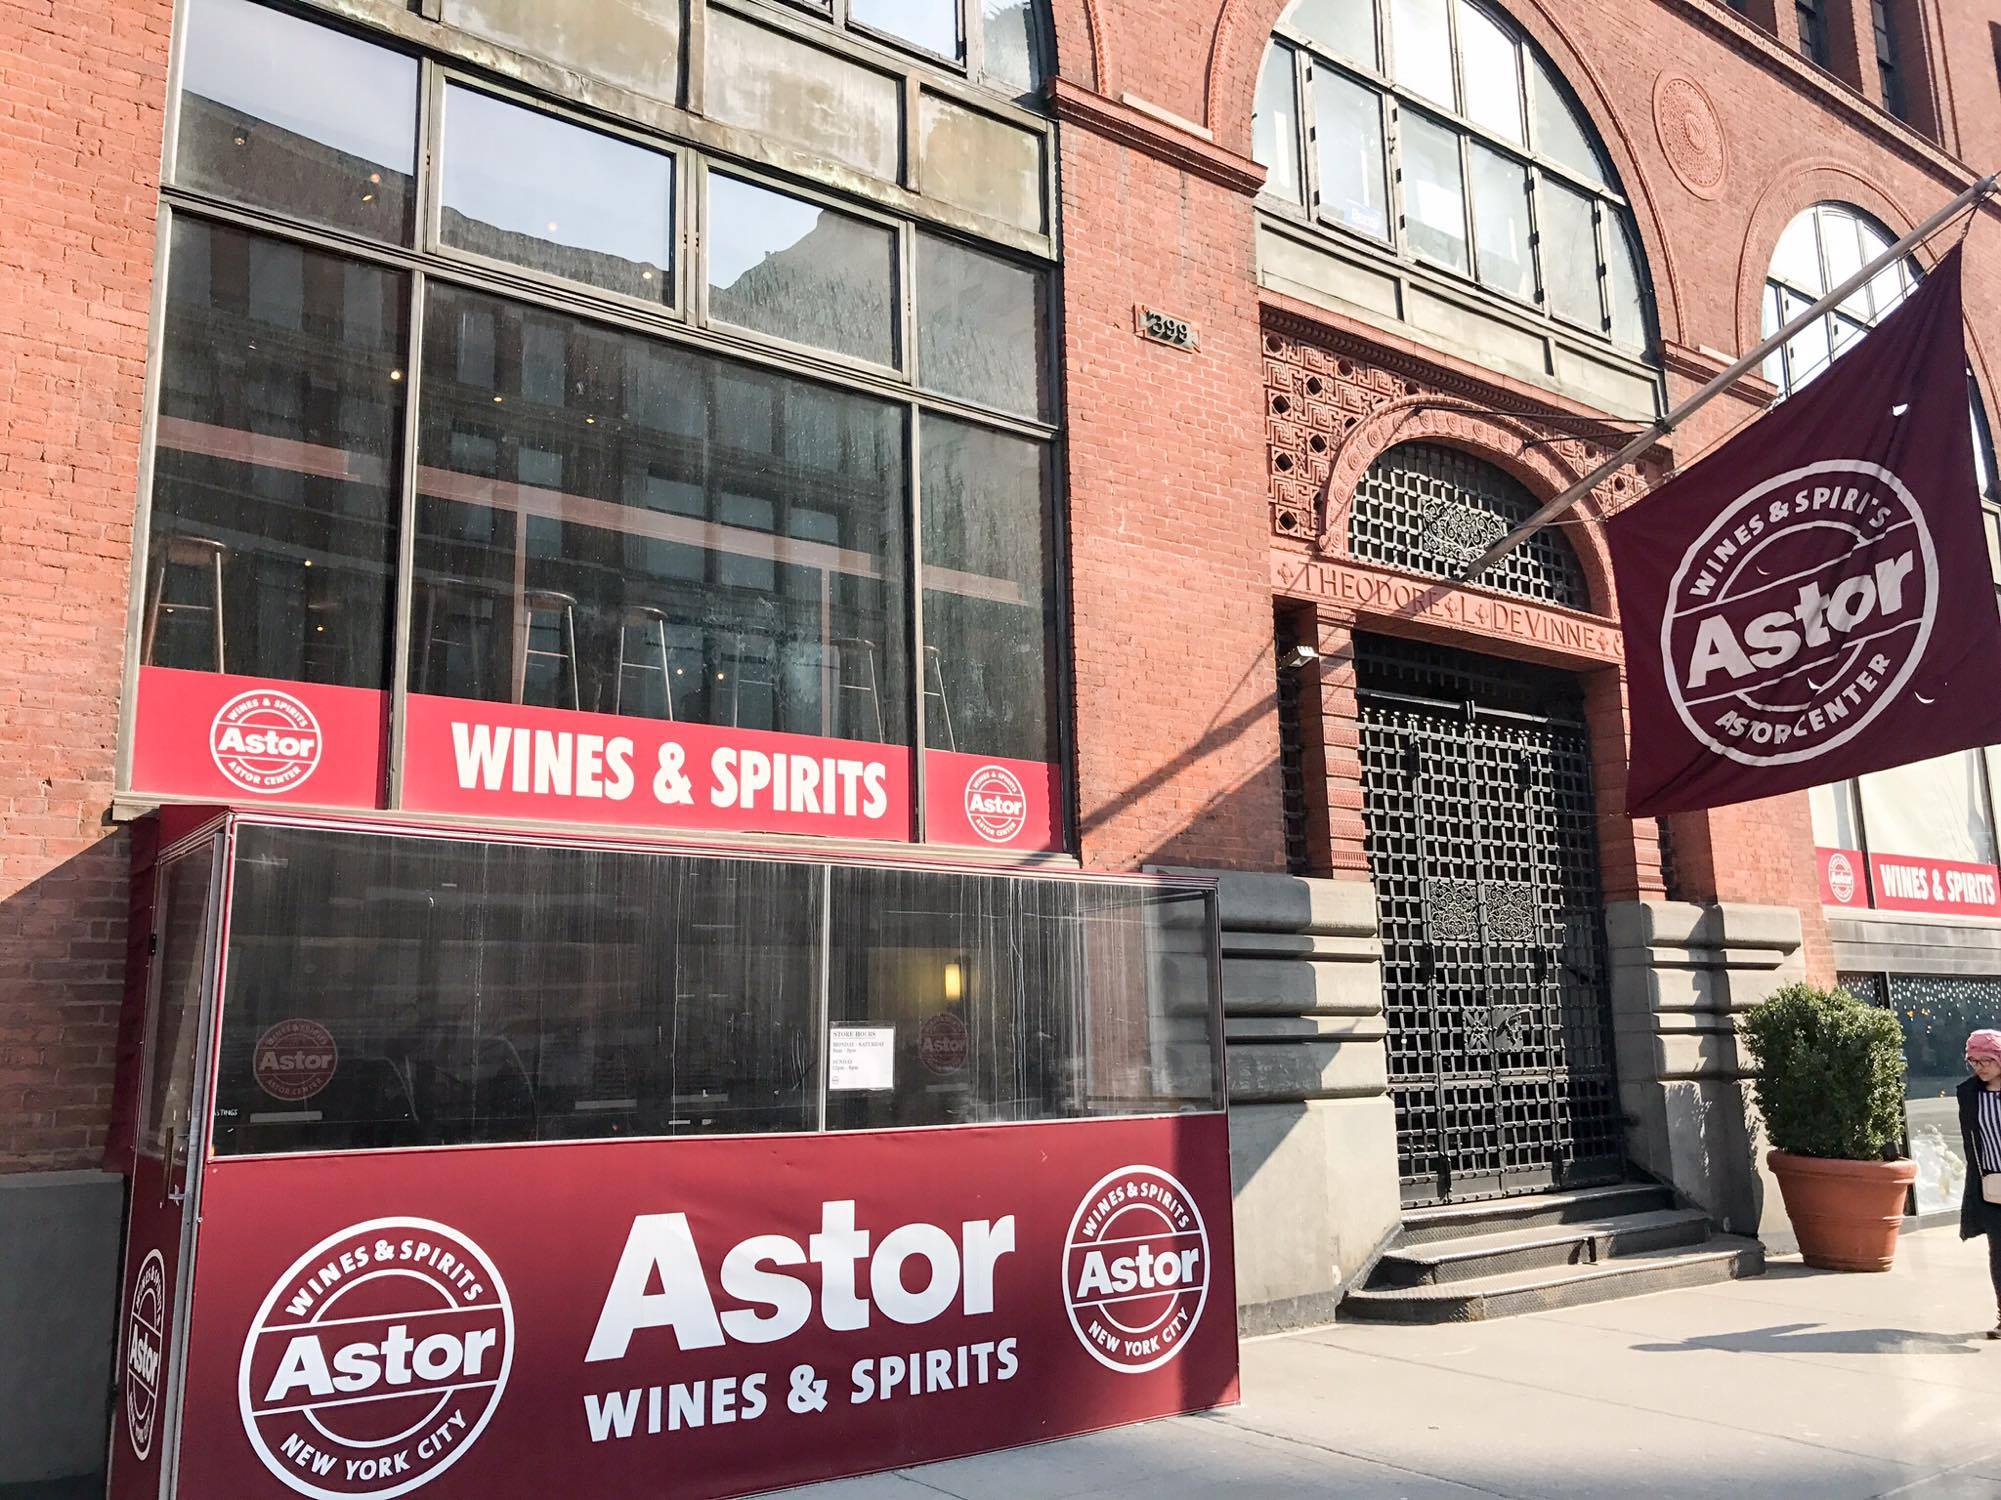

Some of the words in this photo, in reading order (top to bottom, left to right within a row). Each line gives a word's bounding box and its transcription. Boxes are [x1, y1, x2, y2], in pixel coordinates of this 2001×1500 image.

[1689, 514, 1765, 598] WINES
[1769, 500, 1790, 523] &
[1299, 562, 1443, 617] THEODORE
[1686, 549, 1914, 689] Astor
[227, 698, 259, 721] WINES
[262, 697, 271, 706] &
[273, 699, 309, 727] SPIRITS
[1793, 652, 1891, 738] CENTER
[217, 727, 315, 757] Astor
[451, 721, 634, 800] WINES
[653, 741, 695, 805] &
[710, 746, 887, 819] SPIRITS
[228, 761, 261, 784] ASTOR
[264, 766, 302, 786] CENTER
[969, 793, 1022, 815] Astor
[1879, 864, 1929, 900] WINES
[1931, 869, 1944, 901] &
[1946, 870, 1996, 906] SPIRITS
[258, 1050, 333, 1071] Astor
[1082, 1186, 1125, 1237] WINES
[1127, 1181, 1138, 1197] &
[1140, 1182, 1190, 1229] SPIRITS
[285, 1245, 370, 1317] WINES
[374, 1239, 395, 1261] &
[400, 1240, 484, 1301] SPIRITS
[583, 1199, 1016, 1363] Astor
[1076, 1244, 1199, 1298] Astor
[129, 1324, 159, 1386] Astor
[1088, 1320, 1120, 1353] NEW
[1124, 1334, 1161, 1357] YORK
[1162, 1307, 1189, 1343] CITY
[264, 1325, 496, 1402] Astor
[583, 1372, 768, 1443] WINES
[786, 1364, 828, 1414] &
[850, 1337, 1019, 1404] SPIRITS
[279, 1432, 337, 1477] NEW
[346, 1449, 411, 1481] YORK
[417, 1408, 468, 1459] CITY
